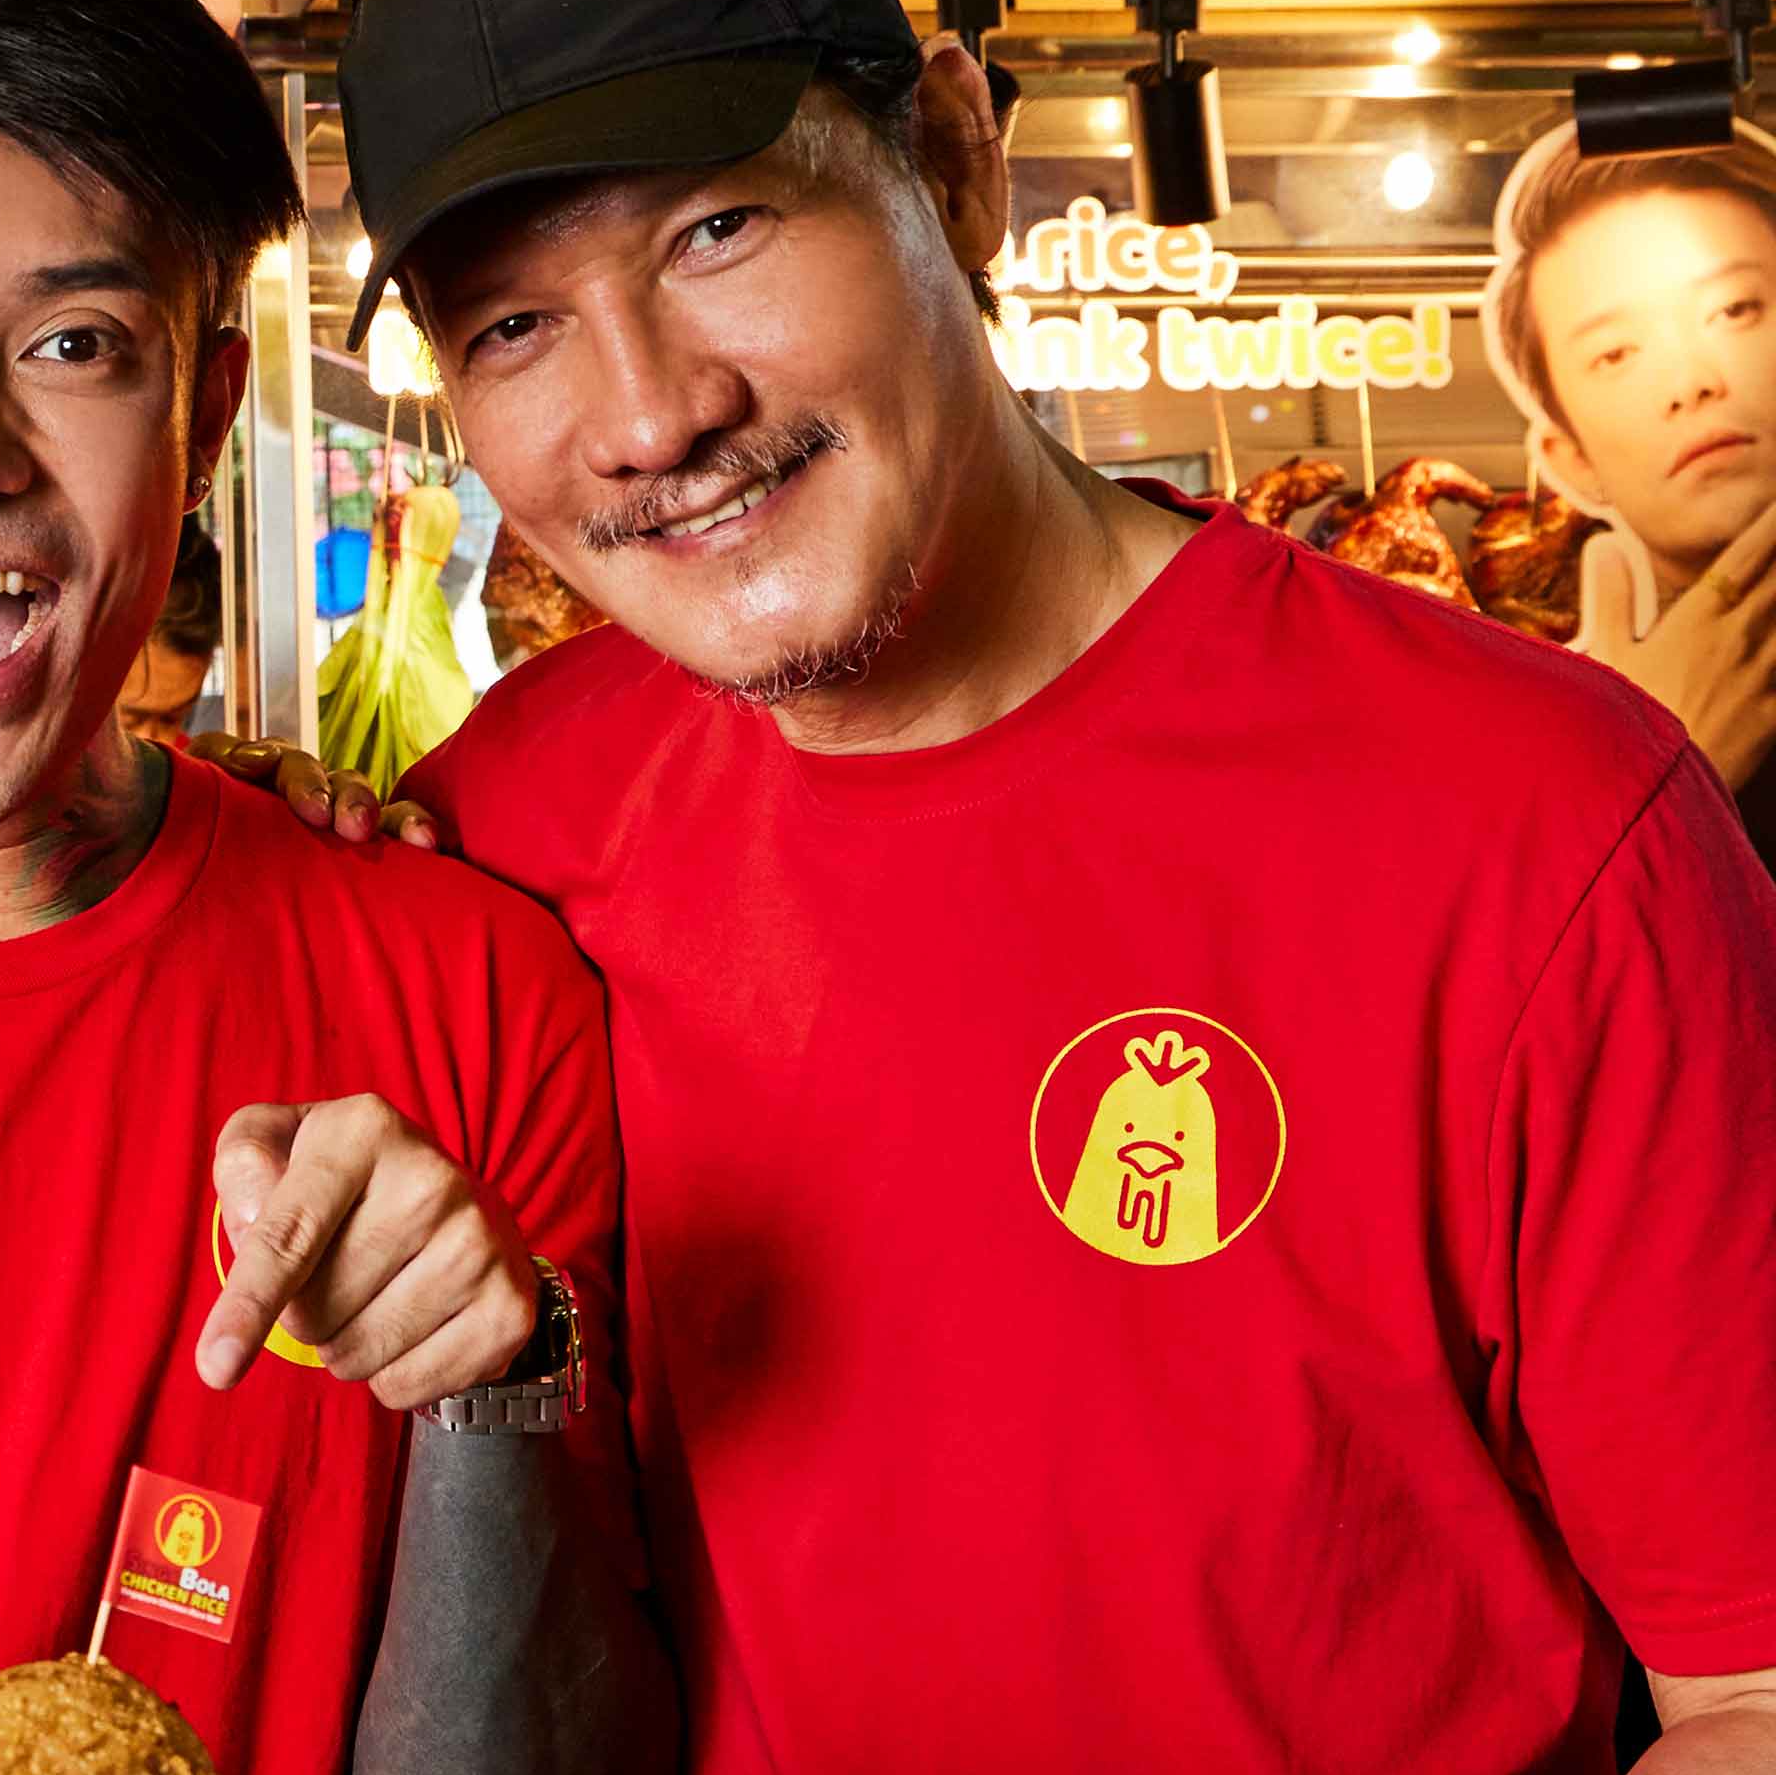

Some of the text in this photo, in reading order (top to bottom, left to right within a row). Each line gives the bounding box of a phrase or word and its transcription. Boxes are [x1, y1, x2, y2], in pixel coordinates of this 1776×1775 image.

[1030, 200, 1235, 297] rice,
[1004, 299, 1451, 387] ink twice!
[120, 1571, 188, 1604] CHICKEN
[191, 1594, 227, 1618] RICE
